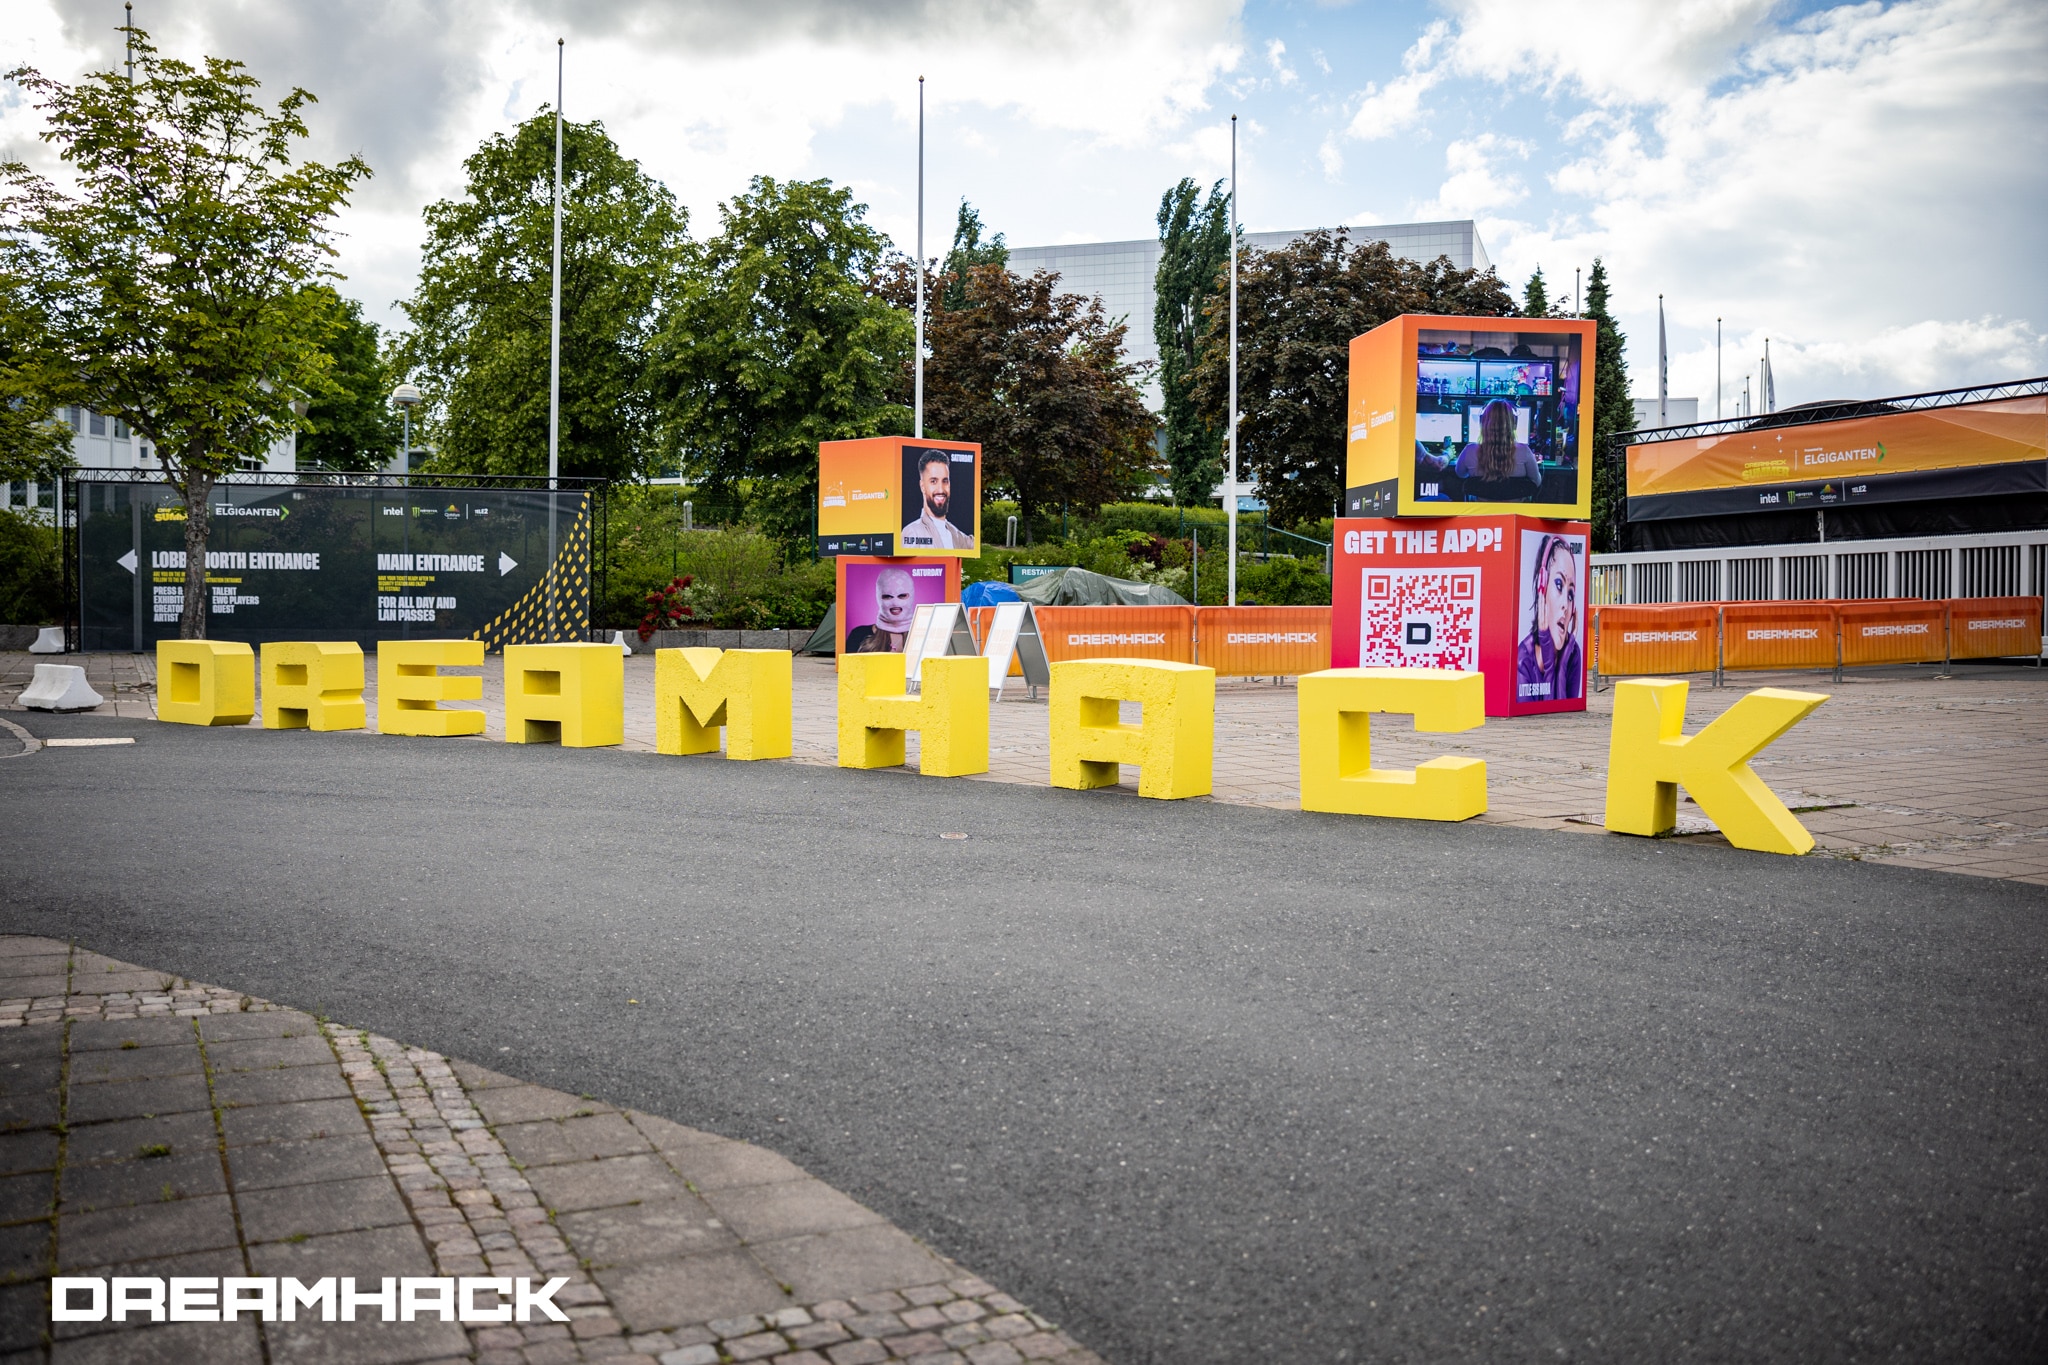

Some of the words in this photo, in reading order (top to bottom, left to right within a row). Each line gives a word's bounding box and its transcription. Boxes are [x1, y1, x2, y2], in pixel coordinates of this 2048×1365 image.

[1804, 448, 1877, 466] ELGIGANTEN
[1420, 483, 1439, 497] LAN
[1760, 492, 1780, 504] intel
[216, 507, 280, 517] ELGIGANTEN
[383, 507, 404, 516] intel
[1344, 531, 1388, 555] GET
[1392, 530, 1438, 554] THE
[1442, 527, 1503, 554] APP!
[152, 551, 187, 569] LOBB
[249, 553, 320, 570] ENTRANCE
[378, 554, 414, 571] MAIN
[416, 555, 485, 572] ENTRANCE
[912, 569, 943, 577] SATURDAY
[153, 586, 177, 595] PRESS
[212, 587, 237, 596] TALENT
[153, 596, 185, 604] EXHIBITO
[229, 596, 260, 605] PLAYERS
[378, 597, 397, 609] FOR
[398, 597, 415, 609] ALL
[416, 597, 435, 609] DAY
[436, 597, 457, 610] AND
[212, 605, 235, 614] GUEST
[378, 609, 397, 621] LAN
[398, 609, 436, 621] PASSES
[154, 614, 179, 622] ARTIST
[1862, 624, 1929, 637] DREAMHACK
[1968, 619, 2026, 631] DREAMHACK
[1068, 633, 1165, 645] DREAMHACK
[1228, 632, 1318, 644] DREAMHACK
[1624, 630, 1698, 643] DREAMHACK
[1747, 629, 1818, 640] DREAMHACK
